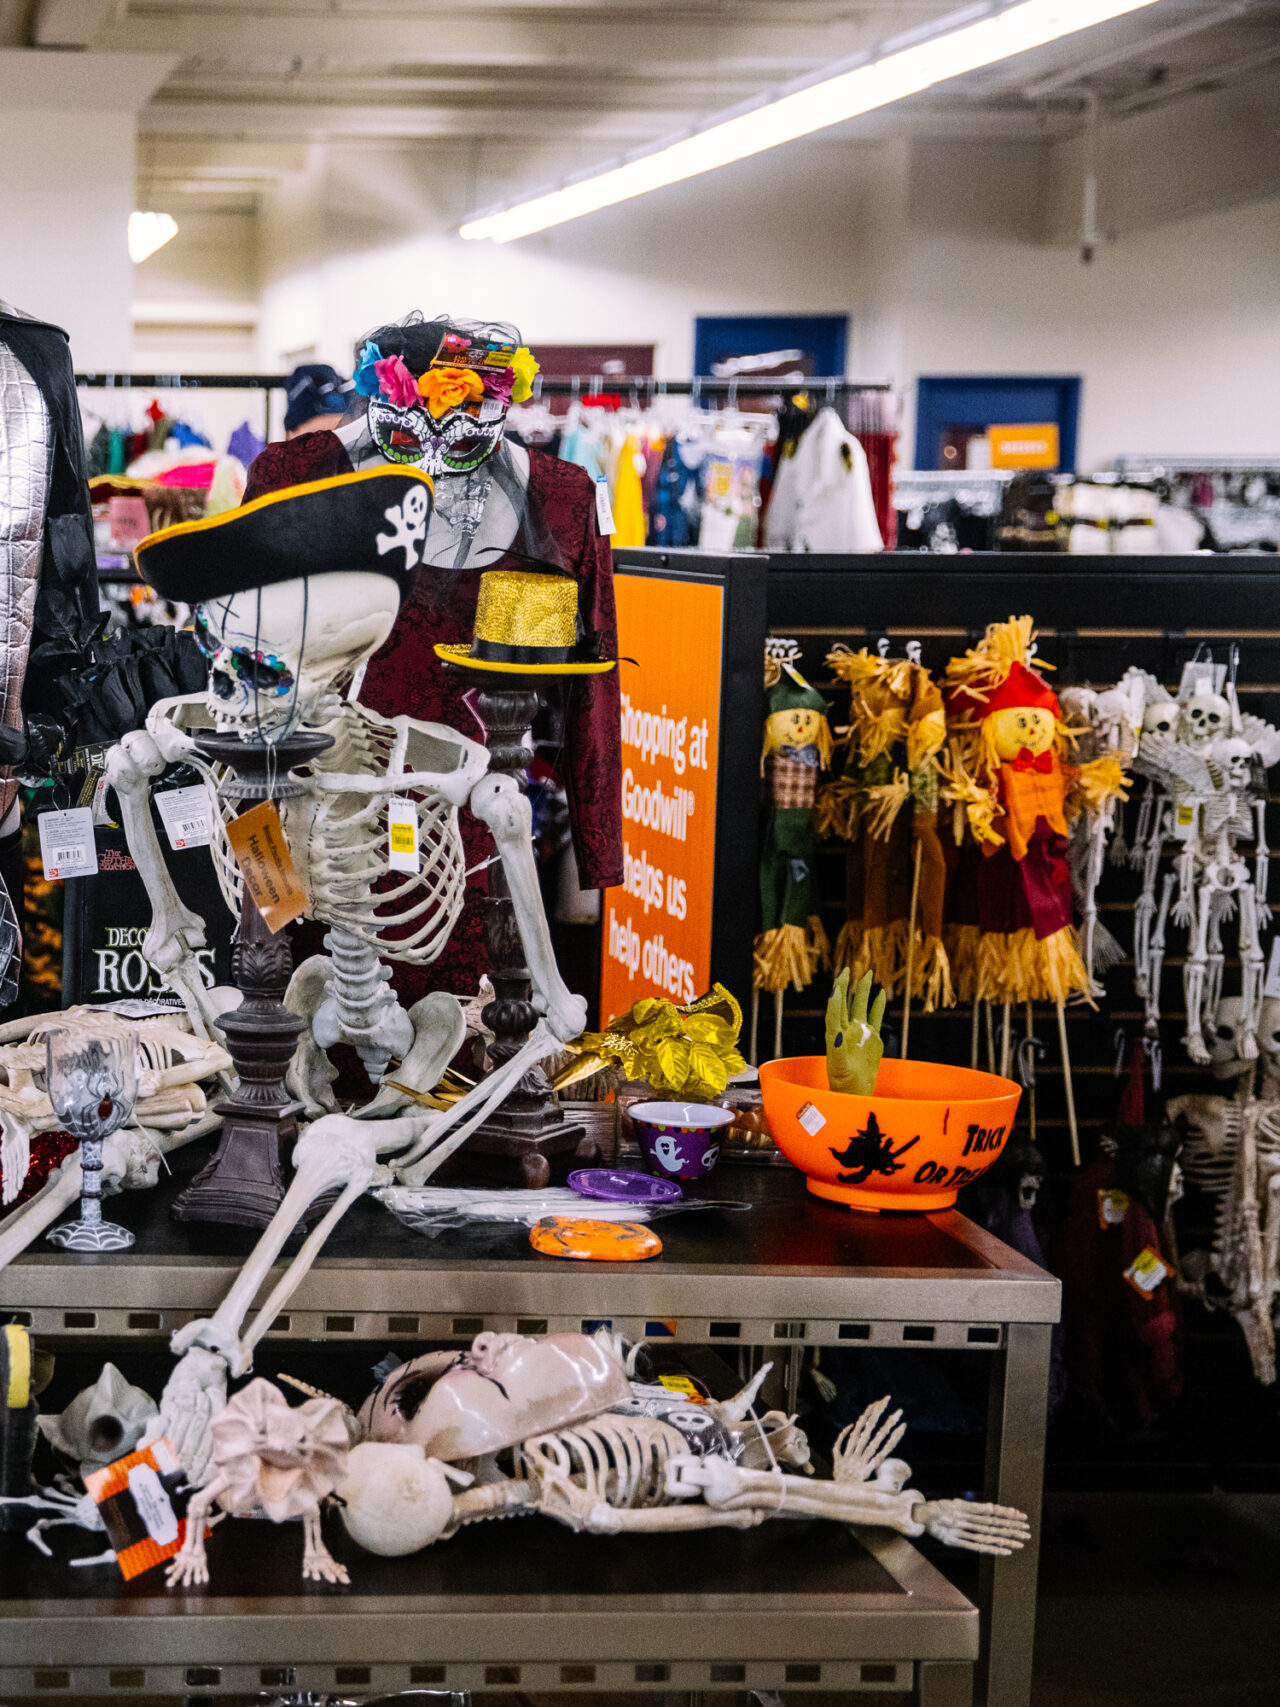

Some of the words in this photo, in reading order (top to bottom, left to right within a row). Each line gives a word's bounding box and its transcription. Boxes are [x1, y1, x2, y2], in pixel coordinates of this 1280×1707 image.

[689, 718, 709, 770] at
[241, 857, 262, 896] Decor
[248, 834, 280, 904] Halloween
[622, 841, 664, 914] helps
[666, 874, 687, 921] us
[608, 907, 641, 981] help
[913, 1161, 948, 1183] OR
